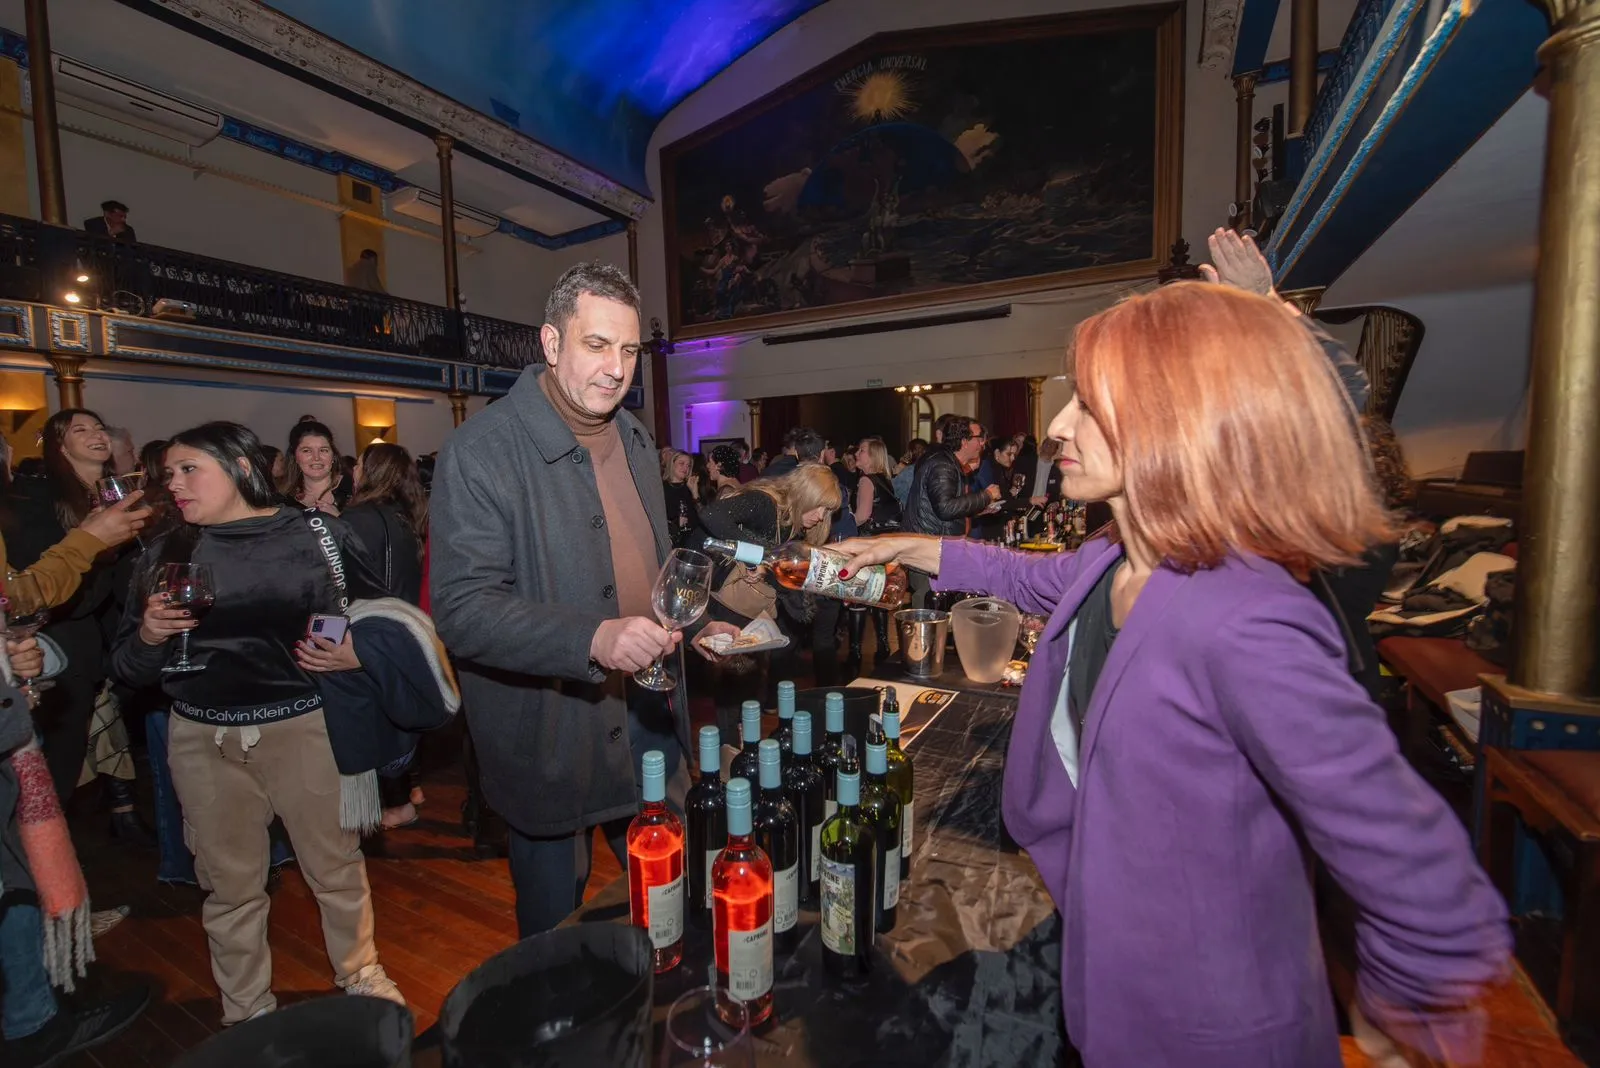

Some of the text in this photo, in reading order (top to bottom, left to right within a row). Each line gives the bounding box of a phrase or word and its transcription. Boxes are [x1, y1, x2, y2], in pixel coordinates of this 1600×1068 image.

[880, 55, 927, 71] UNIVERSAL
[310, 517, 327, 535] JO
[320, 536, 346, 590] JUANITA
[181, 702, 204, 719] Klein
[206, 708, 250, 722] Calvin
[253, 705, 290, 721] Klein
